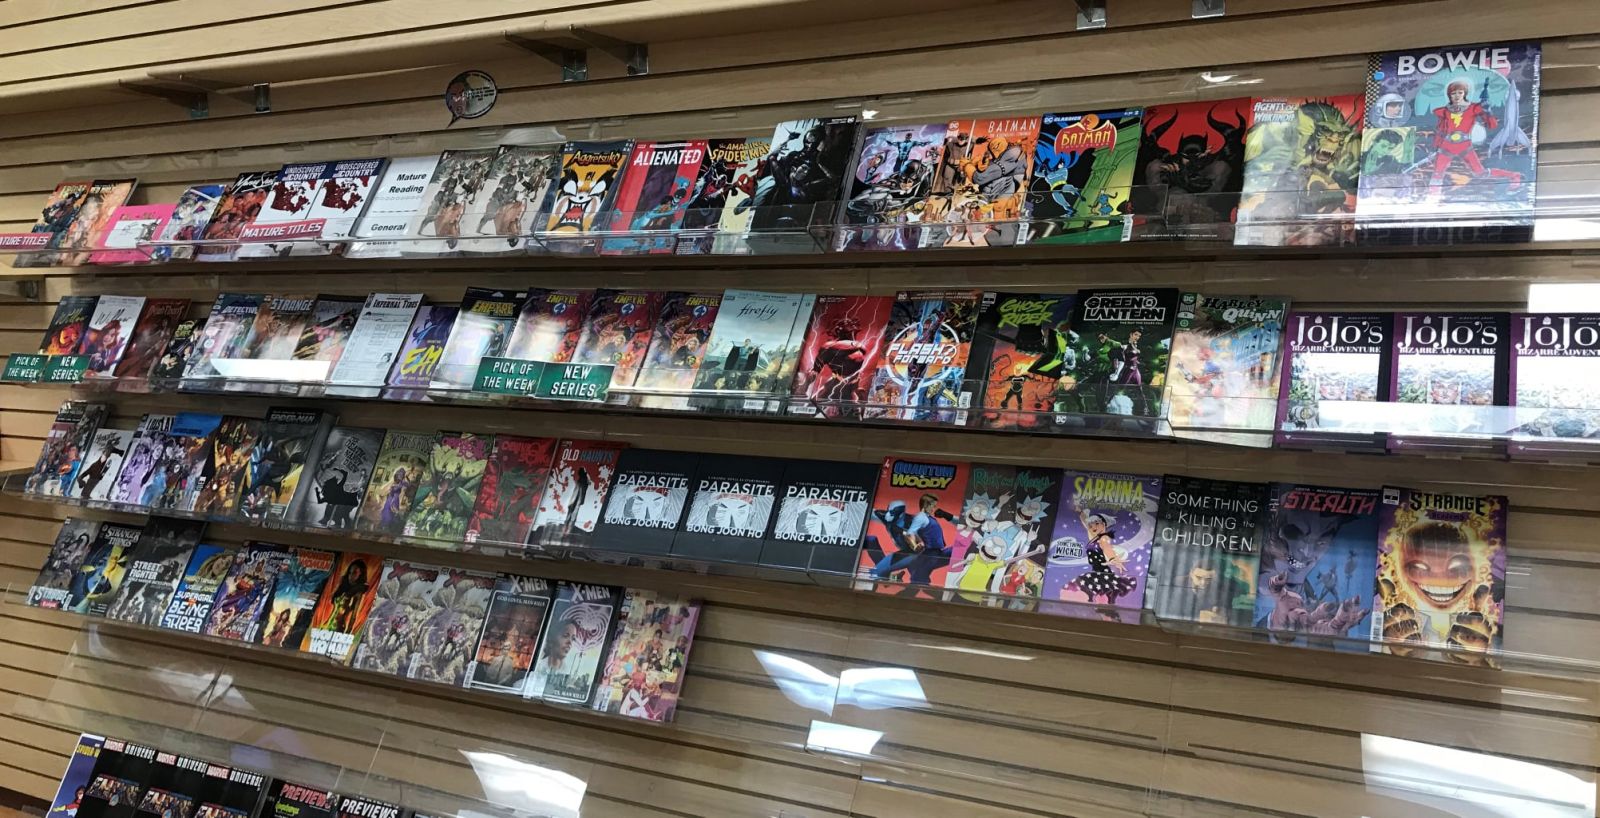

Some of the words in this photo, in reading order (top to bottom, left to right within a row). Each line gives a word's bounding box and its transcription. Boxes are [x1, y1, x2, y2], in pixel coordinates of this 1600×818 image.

[1397, 47, 1510, 75] BOWIE
[1253, 102, 1285, 111] AGENTS
[988, 118, 1038, 134] BATMAN
[1062, 130, 1111, 146] BATMAN
[725, 141, 763, 151] AMAZING
[633, 149, 702, 166] ALIENATED
[285, 164, 326, 175] UNDISCOVERED
[335, 161, 379, 171] UNDISCOVERED
[289, 172, 323, 181] COUNTRY
[340, 169, 374, 178] COUNTRY
[397, 173, 427, 182] Mature
[389, 185, 424, 195] Reading
[242, 227, 286, 239] MATURE
[286, 223, 324, 235] TITLES
[371, 223, 406, 232] General
[0, 236, 22, 246] ATURE
[22, 236, 49, 246] TITLES
[269, 298, 314, 312] STRANGE
[547, 293, 578, 304] EMPYRE
[614, 295, 647, 304] EMPYRE
[686, 296, 719, 306] EMPYRE
[1084, 296, 1146, 309] GREEN
[736, 303, 780, 321] firefly
[1000, 299, 1059, 313] GHOST
[998, 312, 1054, 328] RIDER
[1083, 307, 1166, 321] LANTERN
[887, 343, 946, 356] FLASH
[1292, 344, 1328, 353] BIZARRE
[1329, 344, 1382, 353] ADVENTURE
[1399, 346, 1438, 355] BIZARRE
[1439, 346, 1496, 355] ADVENTURE
[1517, 348, 1561, 357] BIZARRE
[15, 356, 29, 366] PICK
[30, 356, 39, 366] OF
[60, 356, 77, 367] NEW
[893, 354, 952, 364] FORWARD
[8, 367, 19, 377] THE
[20, 368, 38, 378] WEEK
[51, 369, 79, 381] SERIES
[493, 361, 516, 374] PICK
[520, 364, 534, 375] OF
[563, 365, 593, 379] NEW
[482, 376, 502, 388] THE
[505, 378, 534, 391] WEEK
[550, 381, 596, 398] SERIES
[1055, 415, 1067, 424] DC
[561, 448, 580, 461] OLD
[580, 450, 613, 462] HAUNTS
[894, 461, 955, 477] QUANTUM
[617, 474, 688, 490] PARASITE
[891, 474, 953, 488] WOODY
[699, 480, 775, 497] PARASITE
[786, 486, 868, 502] PARASITE
[1074, 476, 1144, 503] SABRINA
[1167, 491, 1258, 512] SOMETHING
[1283, 490, 1377, 515] STEALTH
[1409, 491, 1486, 516] STRANGE
[604, 518, 631, 527] BONG
[632, 518, 659, 529] JOON
[661, 521, 678, 530] HO
[1178, 510, 1237, 530] KILLING
[1243, 520, 1255, 528] the
[105, 527, 142, 544] STRANGER
[686, 524, 715, 534] BONG
[716, 526, 745, 537] JOON
[747, 529, 763, 539] HO
[108, 537, 132, 547] THINGS
[775, 532, 805, 541] BONG
[807, 534, 837, 544] JOON
[839, 537, 857, 547] HO
[1161, 527, 1253, 551] CHILDREN
[1056, 547, 1083, 557] WICKED
[132, 560, 161, 572] STREET
[128, 569, 158, 580] FIGHTER
[168, 600, 210, 619] BEING
[155, 751, 177, 766] MARVEL
[207, 764, 230, 779] MARVEL
[340, 799, 398, 818] PREVIEWS
